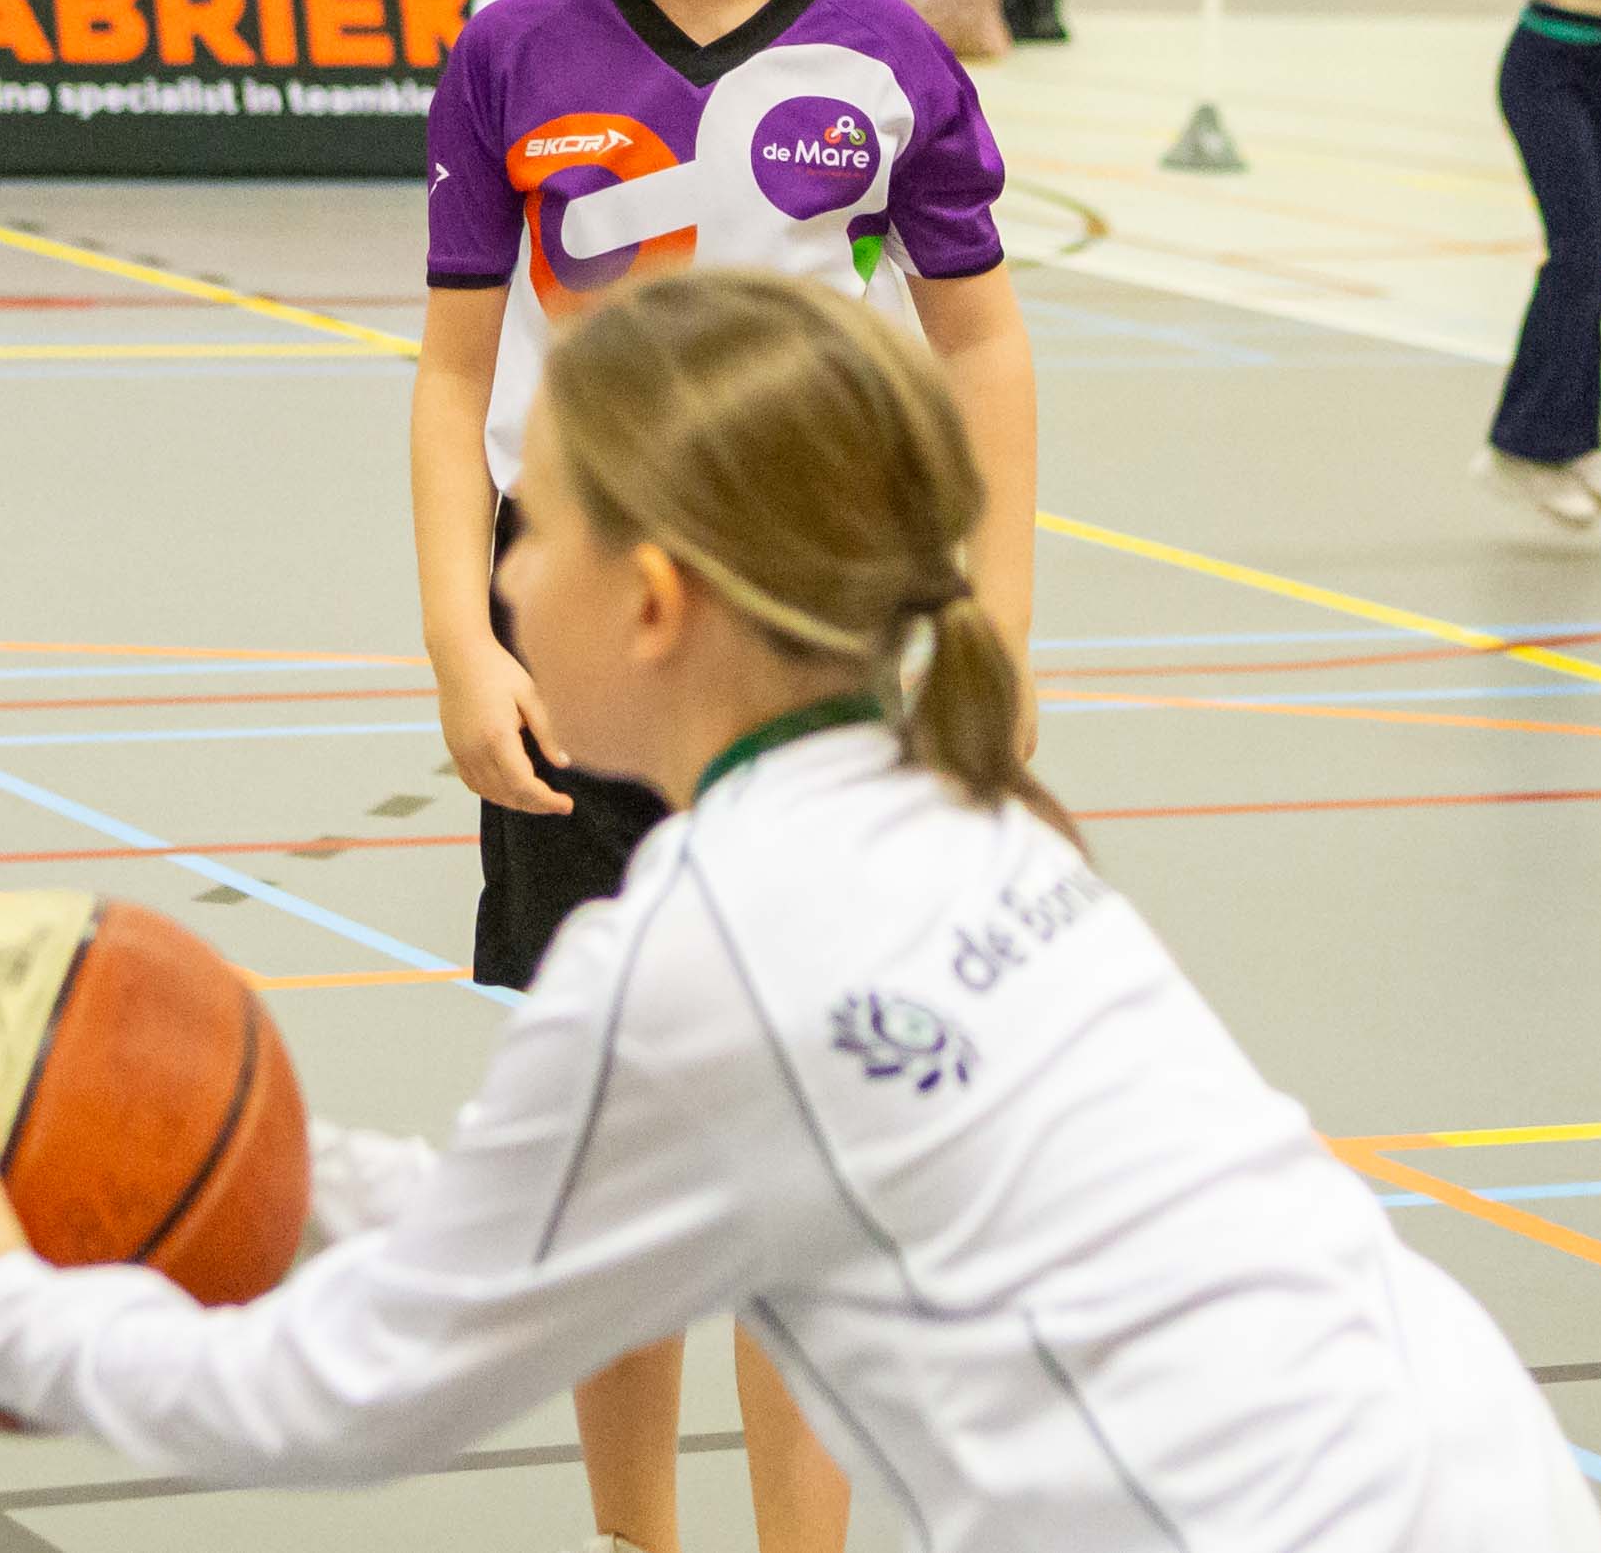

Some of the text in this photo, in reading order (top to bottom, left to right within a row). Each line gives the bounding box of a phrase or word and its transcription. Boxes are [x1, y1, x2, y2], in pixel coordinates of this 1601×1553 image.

[57, 75, 238, 121] specialist
[242, 76, 284, 115] in
[525, 134, 606, 157] SKOR
[762, 139, 870, 169] de Mare
